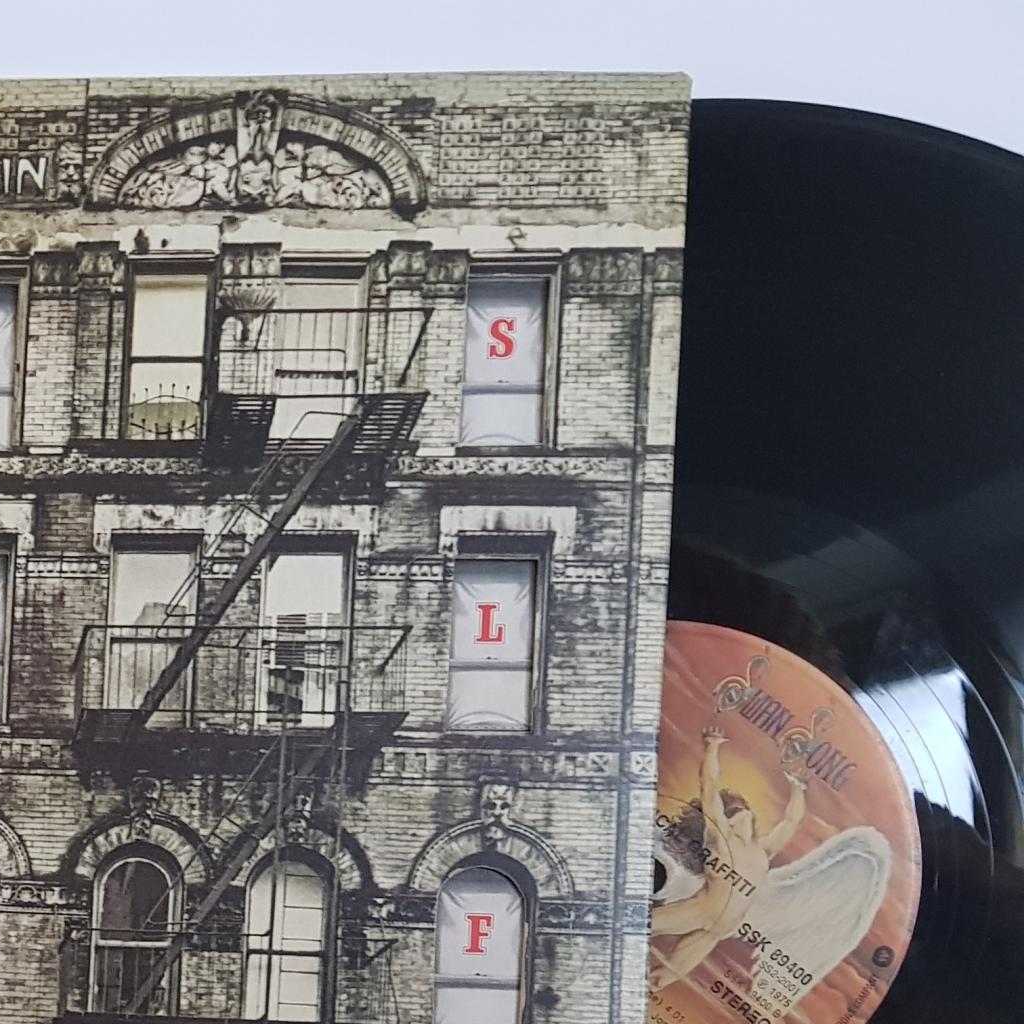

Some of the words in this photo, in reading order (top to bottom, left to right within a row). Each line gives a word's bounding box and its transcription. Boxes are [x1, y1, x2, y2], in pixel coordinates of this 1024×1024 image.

[488, 319, 515, 359] S
[476, 604, 505, 644] L
[688, 838, 756, 897] GRAFFITI
[464, 914, 495, 954] F
[738, 922, 772, 953] SSK
[769, 948, 814, 986] 89400
[770, 987, 793, 1008] 1975
